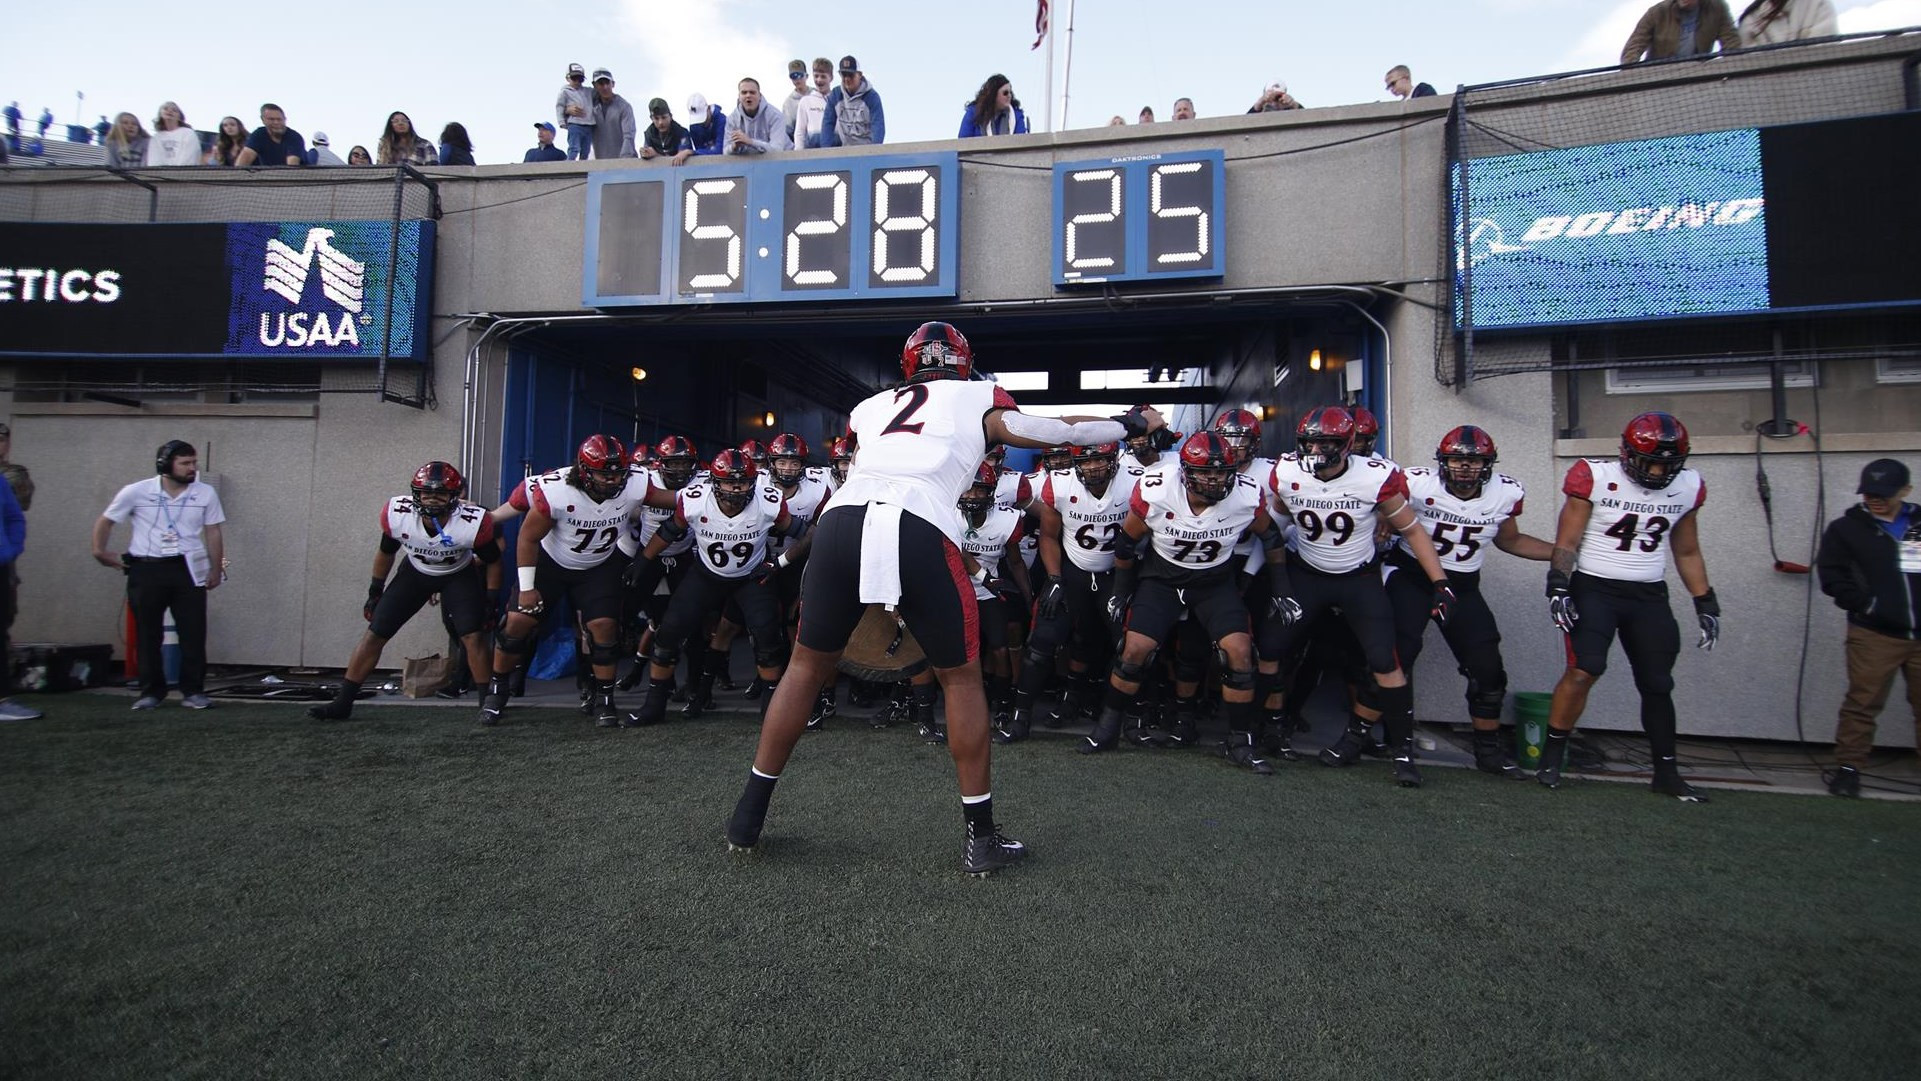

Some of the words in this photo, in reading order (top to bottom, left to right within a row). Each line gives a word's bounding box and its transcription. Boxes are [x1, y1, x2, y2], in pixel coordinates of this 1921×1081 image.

[1111, 154, 1162, 163] DAKTRONICS
[1066, 162, 1209, 268] 25
[1520, 197, 1764, 242] BOEING
[685, 168, 936, 288] 5:28
[0, 267, 122, 303] ETICS
[260, 312, 359, 347] USAA
[880, 384, 929, 436] 2
[1145, 472, 1163, 488] 73
[764, 486, 779, 503] 69
[1290, 496, 1304, 506] SAN
[1306, 500, 1333, 509] DIEGO
[1334, 500, 1361, 510] STATE
[394, 498, 413, 513] 44
[460, 507, 480, 523] 44
[1600, 498, 1621, 508] SAN
[1623, 502, 1655, 514] DIEGO
[1656, 504, 1683, 514] STATE
[567, 517, 581, 527] SAN
[583, 519, 607, 529] DIEGO
[608, 511, 629, 525] STATE
[1069, 511, 1083, 520] SAN
[1084, 514, 1107, 523] DIEGO
[1108, 511, 1128, 522] STATE
[1424, 509, 1440, 520] SAN
[1443, 514, 1471, 525] DIEGO
[701, 530, 714, 539] SAN
[715, 532, 739, 541] DIEGO
[739, 529, 761, 540] STATE
[1075, 523, 1123, 552] 62
[1165, 526, 1181, 537] SAN
[1182, 530, 1208, 540] DIEGO
[1210, 526, 1235, 538] STATE
[1297, 510, 1355, 546] 99
[1604, 513, 1670, 552] 43
[570, 526, 619, 554] 72
[1432, 522, 1484, 562] 55
[414, 547, 439, 556] DIEGO
[707, 542, 754, 569] 69
[1172, 539, 1222, 563] 73
